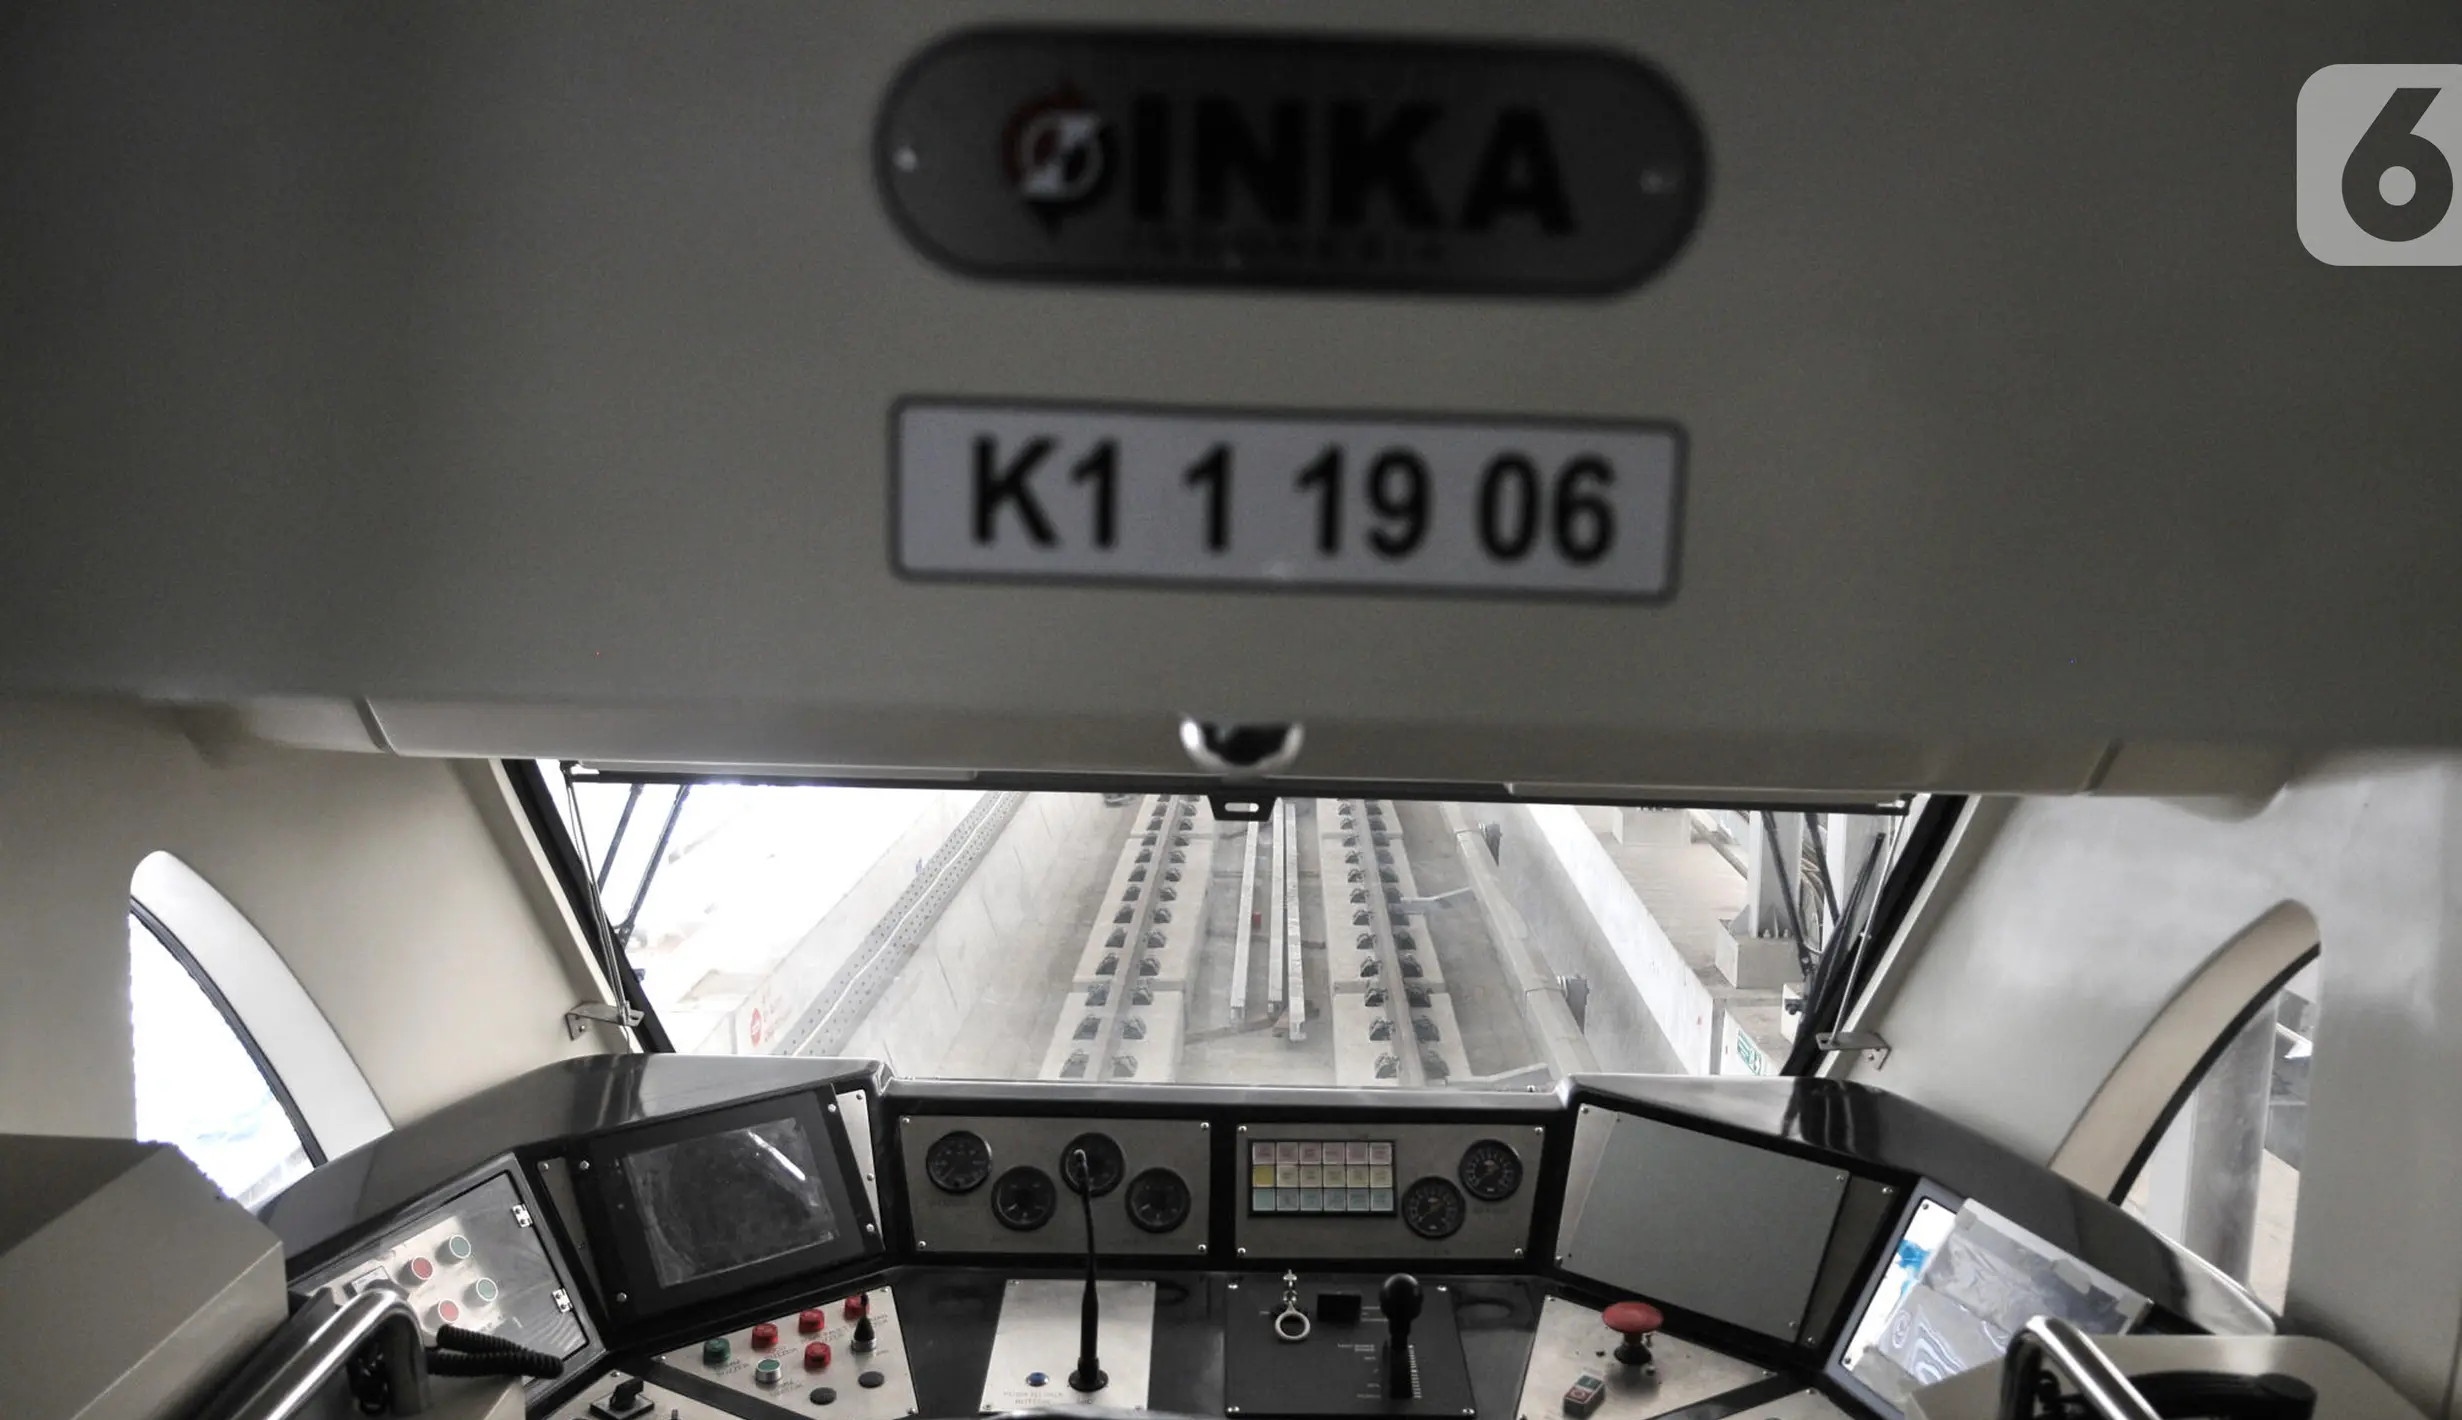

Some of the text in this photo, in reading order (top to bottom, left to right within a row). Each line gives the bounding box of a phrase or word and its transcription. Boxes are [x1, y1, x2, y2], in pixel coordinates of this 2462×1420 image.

[1132, 92, 1574, 235] INKA
[970, 433, 1619, 570] K1 1 19 06
